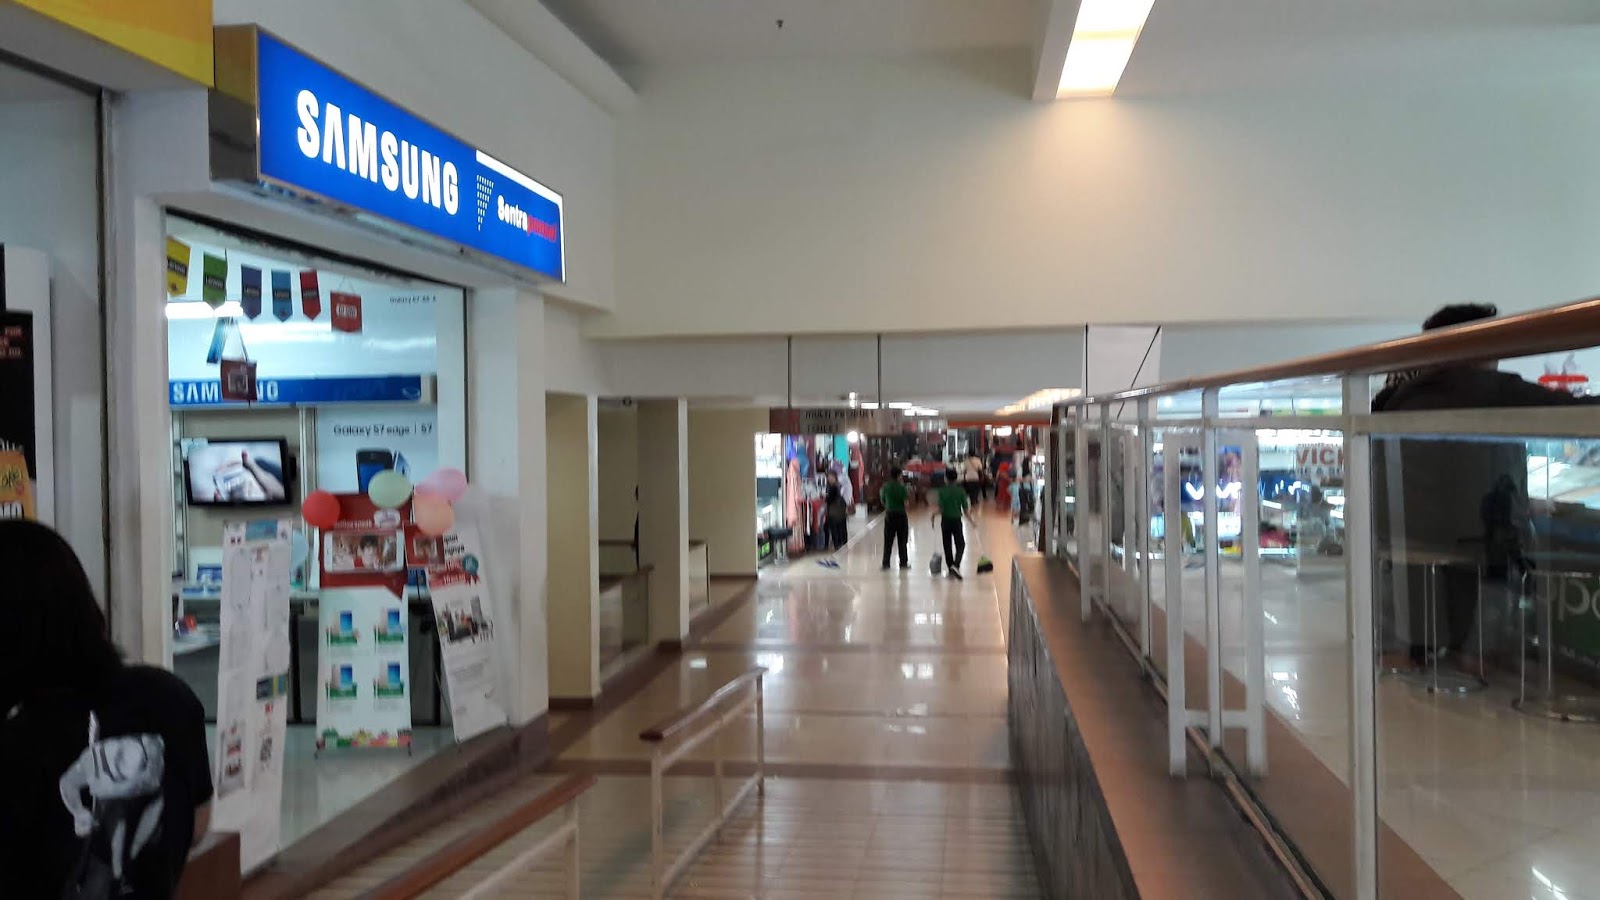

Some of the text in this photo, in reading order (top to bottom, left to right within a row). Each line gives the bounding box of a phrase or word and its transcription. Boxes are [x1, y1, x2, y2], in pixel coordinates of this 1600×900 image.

[297, 89, 459, 215] SAMSUNG
[173, 381, 279, 403] SAMNG
[333, 424, 371, 438] Galaxy
[386, 425, 410, 436] edge
